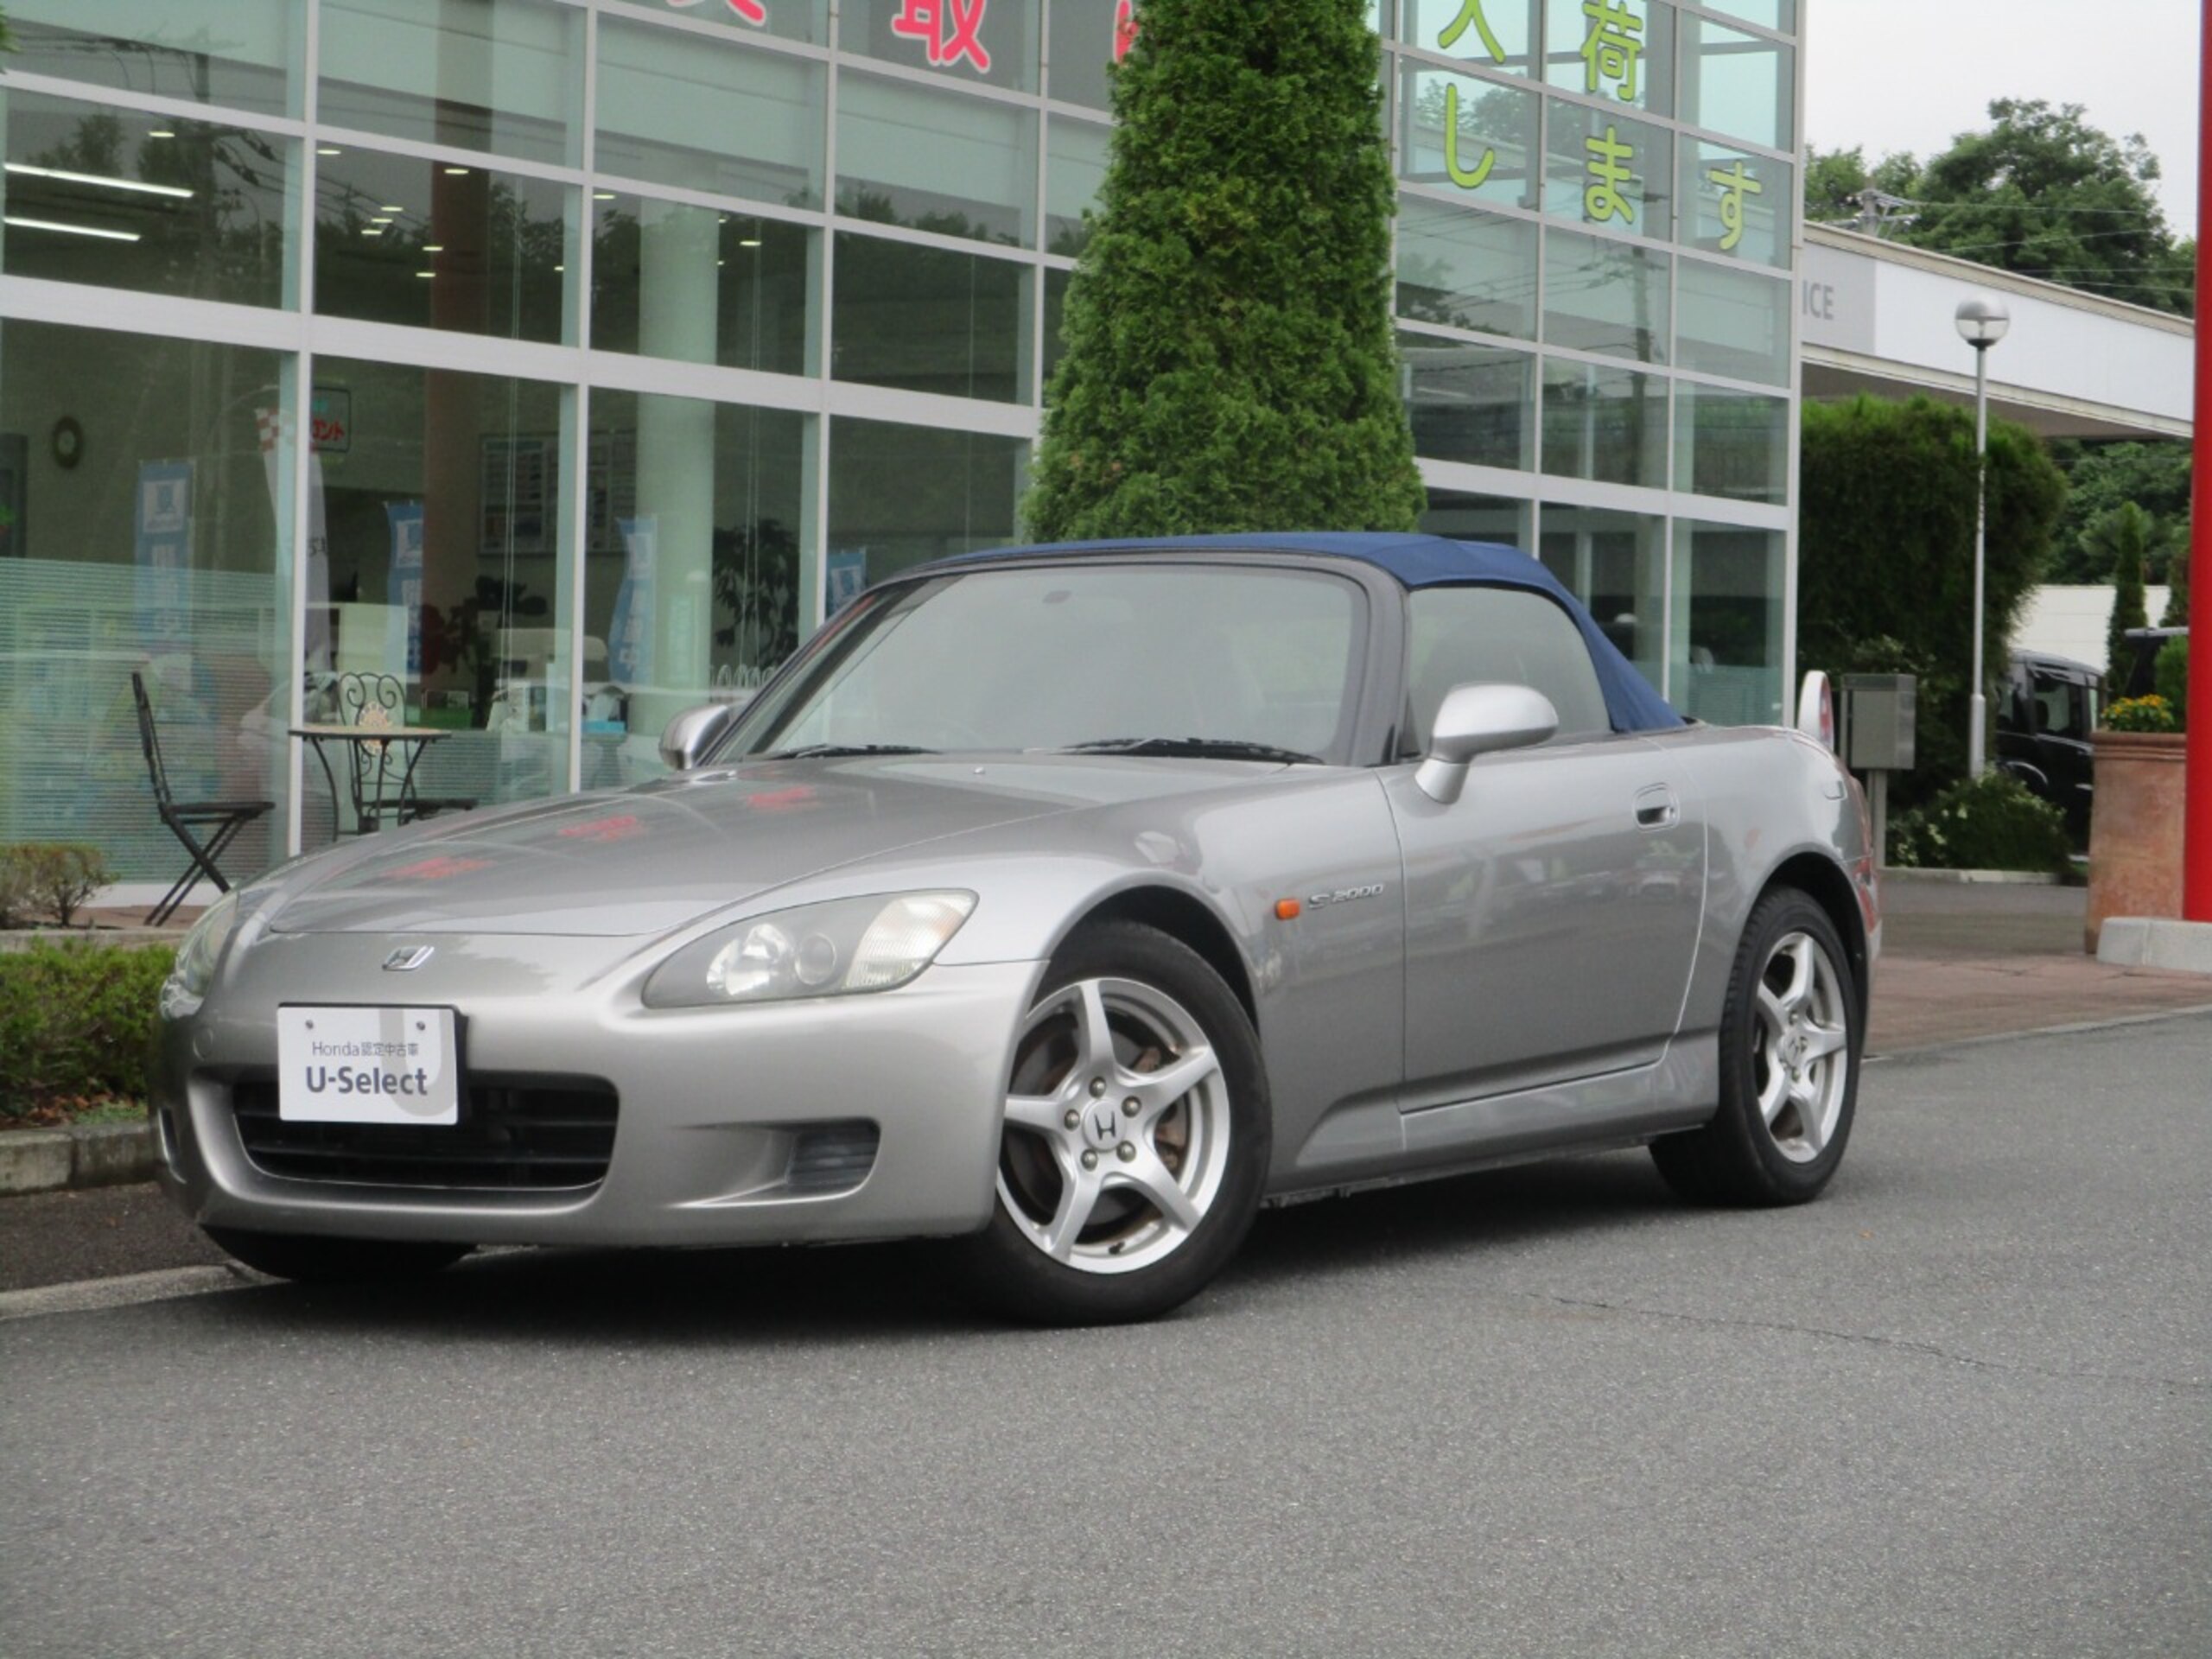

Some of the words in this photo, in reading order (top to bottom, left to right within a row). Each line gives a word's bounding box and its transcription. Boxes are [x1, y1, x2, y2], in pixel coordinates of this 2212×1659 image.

[1444, 81, 1762, 251] します
[1802, 280, 1834, 321] ICE
[306, 1065, 428, 1096] U-Select
